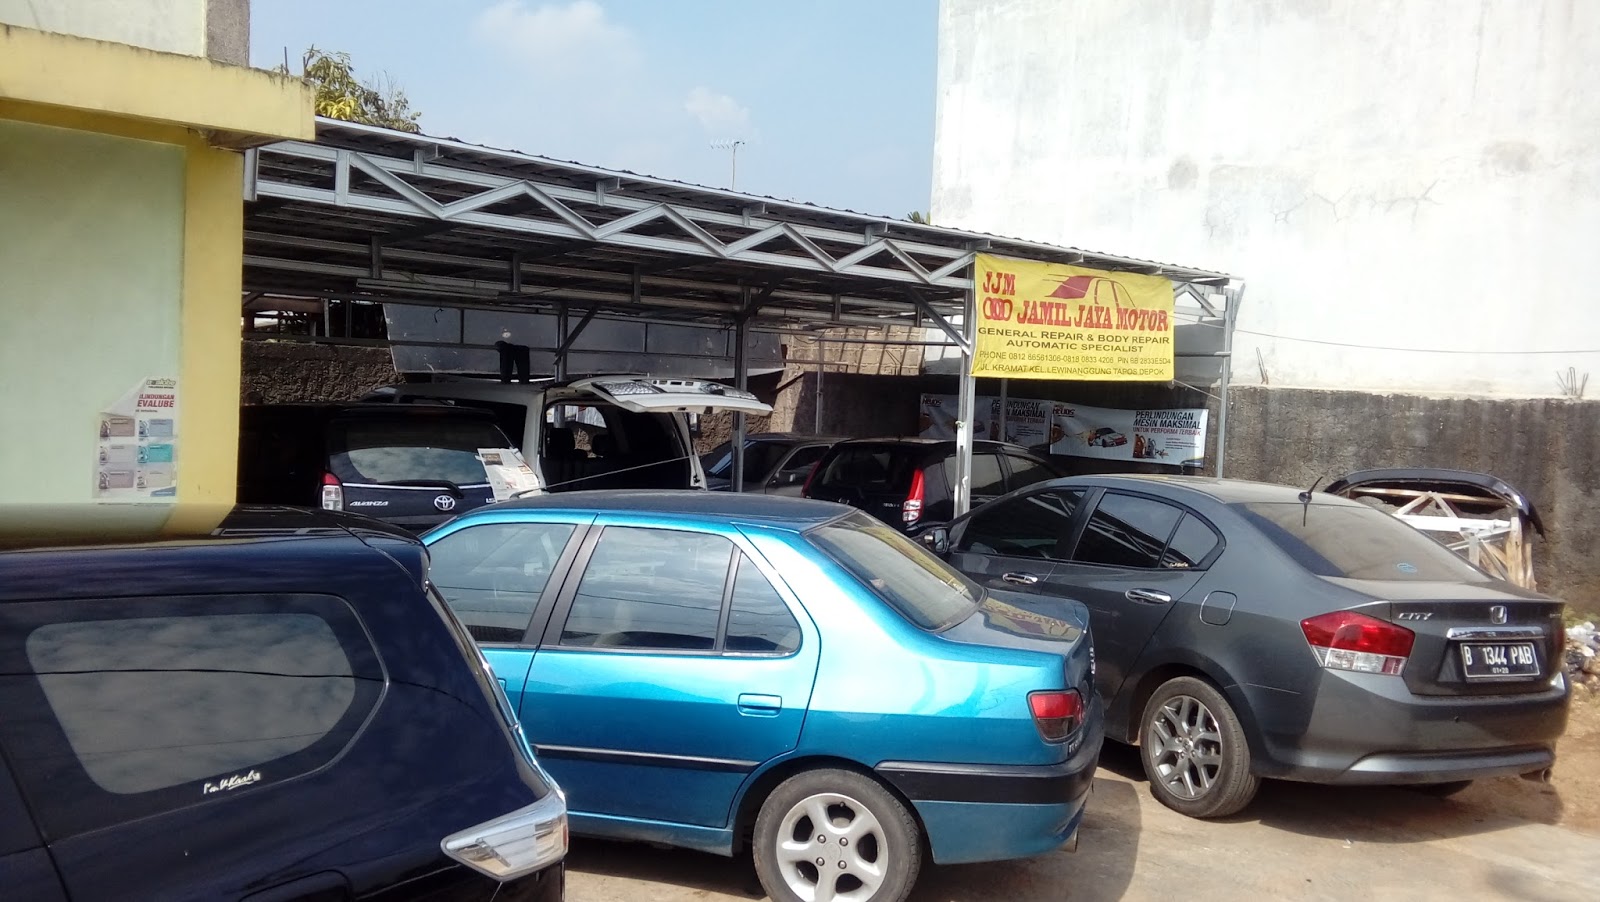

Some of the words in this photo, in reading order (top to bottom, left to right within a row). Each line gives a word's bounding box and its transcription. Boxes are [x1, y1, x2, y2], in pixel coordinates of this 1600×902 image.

[983, 271, 1016, 296] JJM
[1017, 300, 1072, 327] JAMIL
[1074, 304, 1113, 330] JAYA
[1115, 307, 1169, 332] MOTOR
[978, 327, 1038, 339] GENERAL
[1041, 330, 1084, 341] REPAIR
[1086, 333, 1094, 342] &
[1098, 334, 1129, 343] BODY
[1131, 336, 1170, 344] REPAIR
[1006, 339, 1077, 350] AUTOMATIC
[1081, 343, 1144, 353] SPECIALIST
[979, 350, 1007, 360] PHONE
[1008, 352, 1026, 361] 0812
[137, 399, 175, 408] EVALUBE
[991, 399, 1041, 410] PEINDUNGAN
[1012, 408, 1046, 418] MAKSIMAL
[1135, 410, 1194, 421] PERLINDUNGAN
[1132, 418, 1158, 428] MESIN
[1159, 419, 1202, 430] MAKSIMAL
[1150, 427, 1178, 435] PERFORMA
[1178, 428, 1201, 436] TERBAIK
[1398, 612, 1434, 621] CITY
[1463, 645, 1473, 666] B
[1482, 645, 1508, 666] 1344
[1510, 645, 1533, 665] PAB
